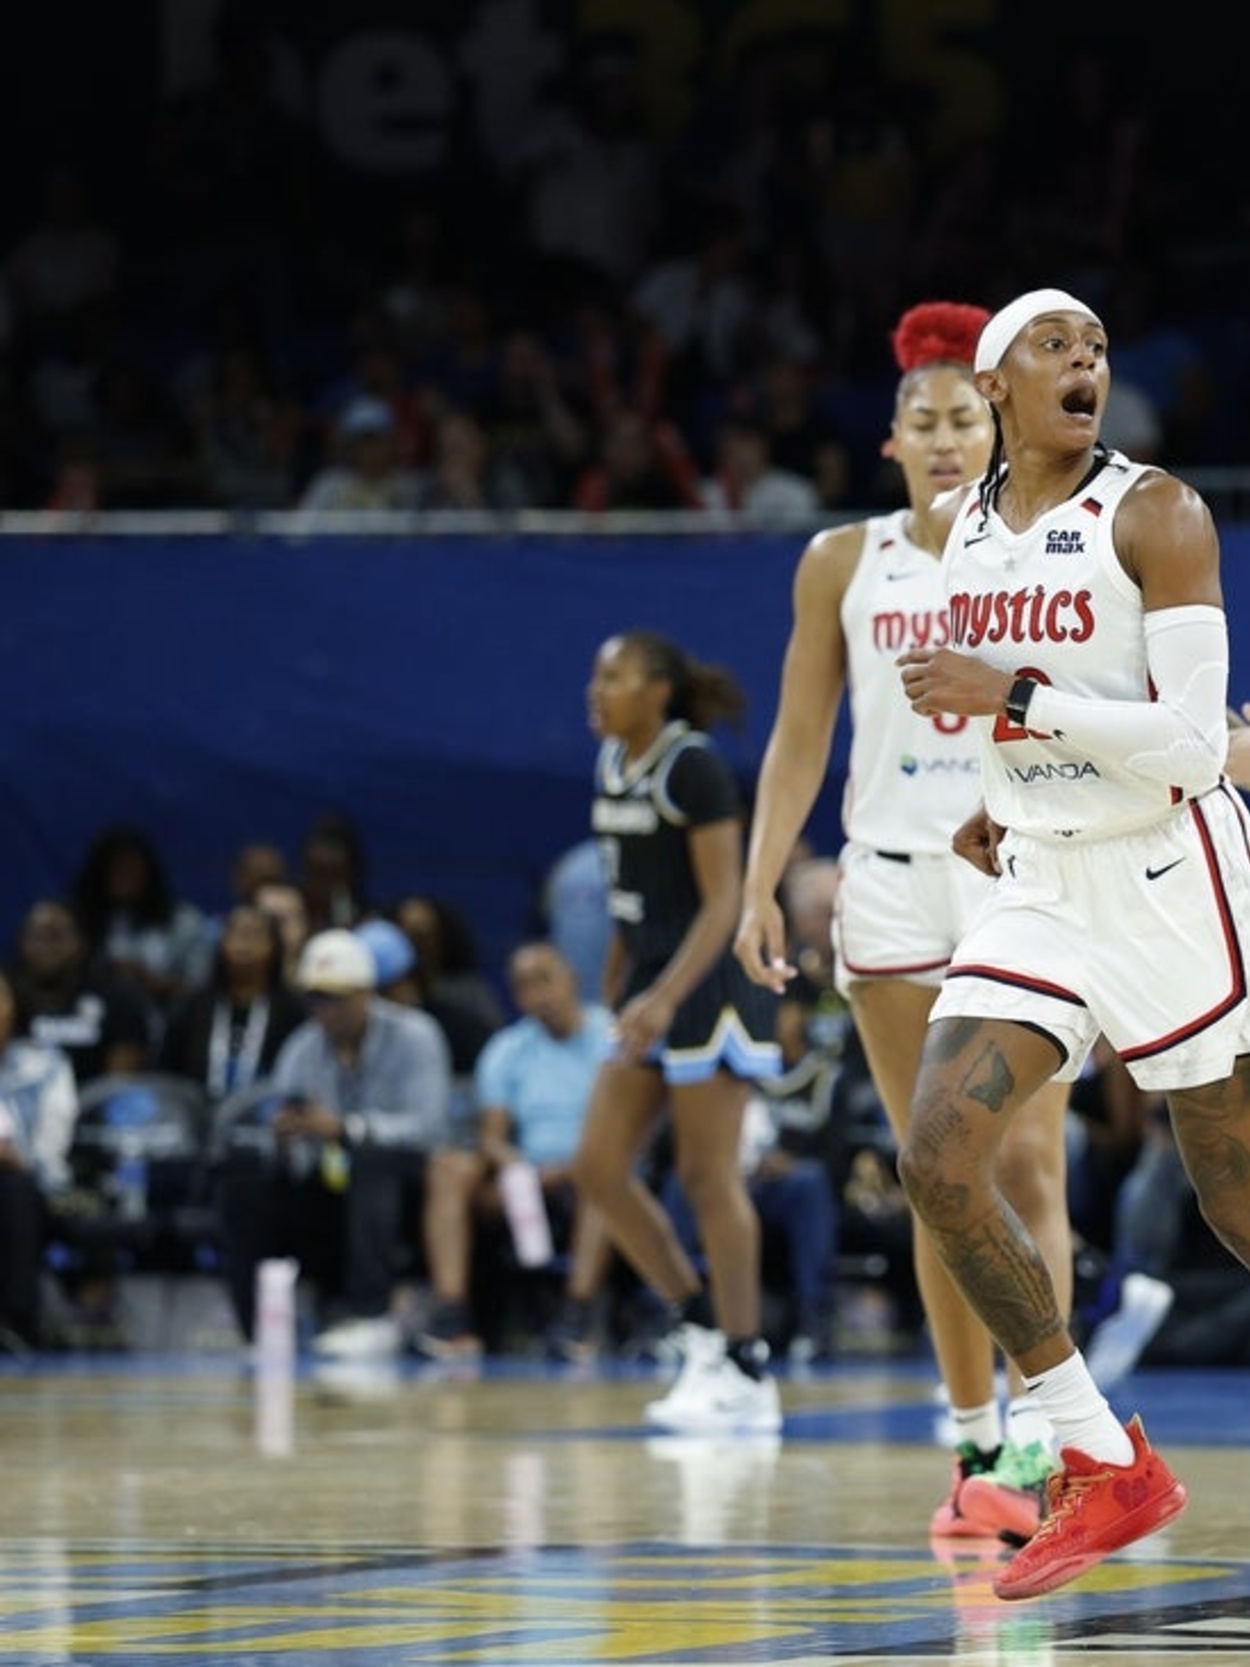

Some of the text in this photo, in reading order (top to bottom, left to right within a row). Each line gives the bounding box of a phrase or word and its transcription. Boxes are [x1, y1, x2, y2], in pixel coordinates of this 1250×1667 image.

[1046, 530, 1081, 542] CAR
[1045, 543, 1085, 554] max
[950, 584, 1096, 648] mystics
